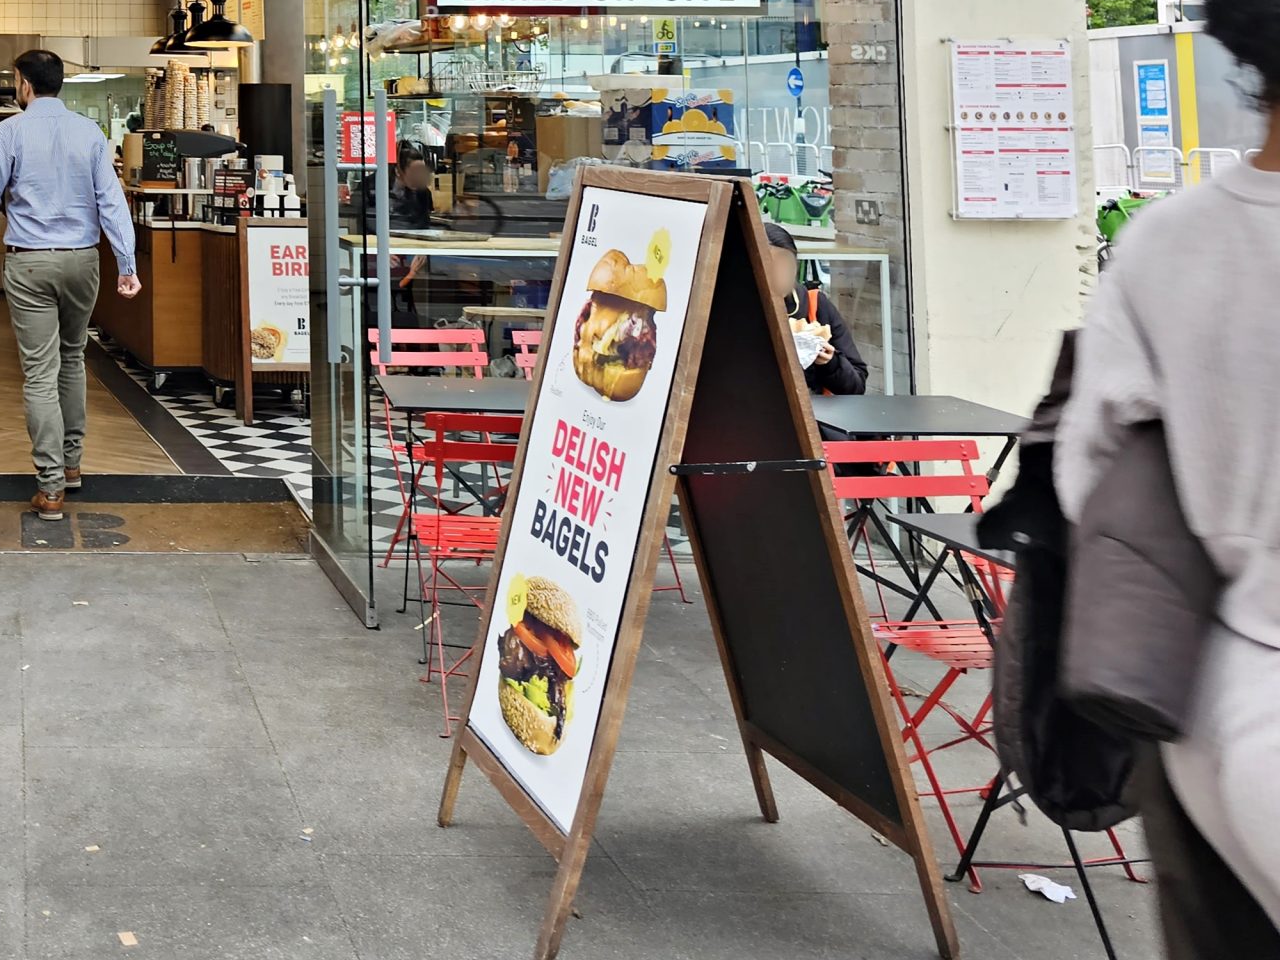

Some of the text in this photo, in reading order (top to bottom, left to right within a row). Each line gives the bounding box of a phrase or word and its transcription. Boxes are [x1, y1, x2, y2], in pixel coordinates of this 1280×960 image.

[270, 245, 308, 259] EAR
[581, 235, 597, 247] BAGEL
[582, 410, 596, 429] Enjoy
[552, 419, 626, 492] DELISH
[554, 467, 605, 528] NEW
[530, 499, 609, 584] BAGELS
